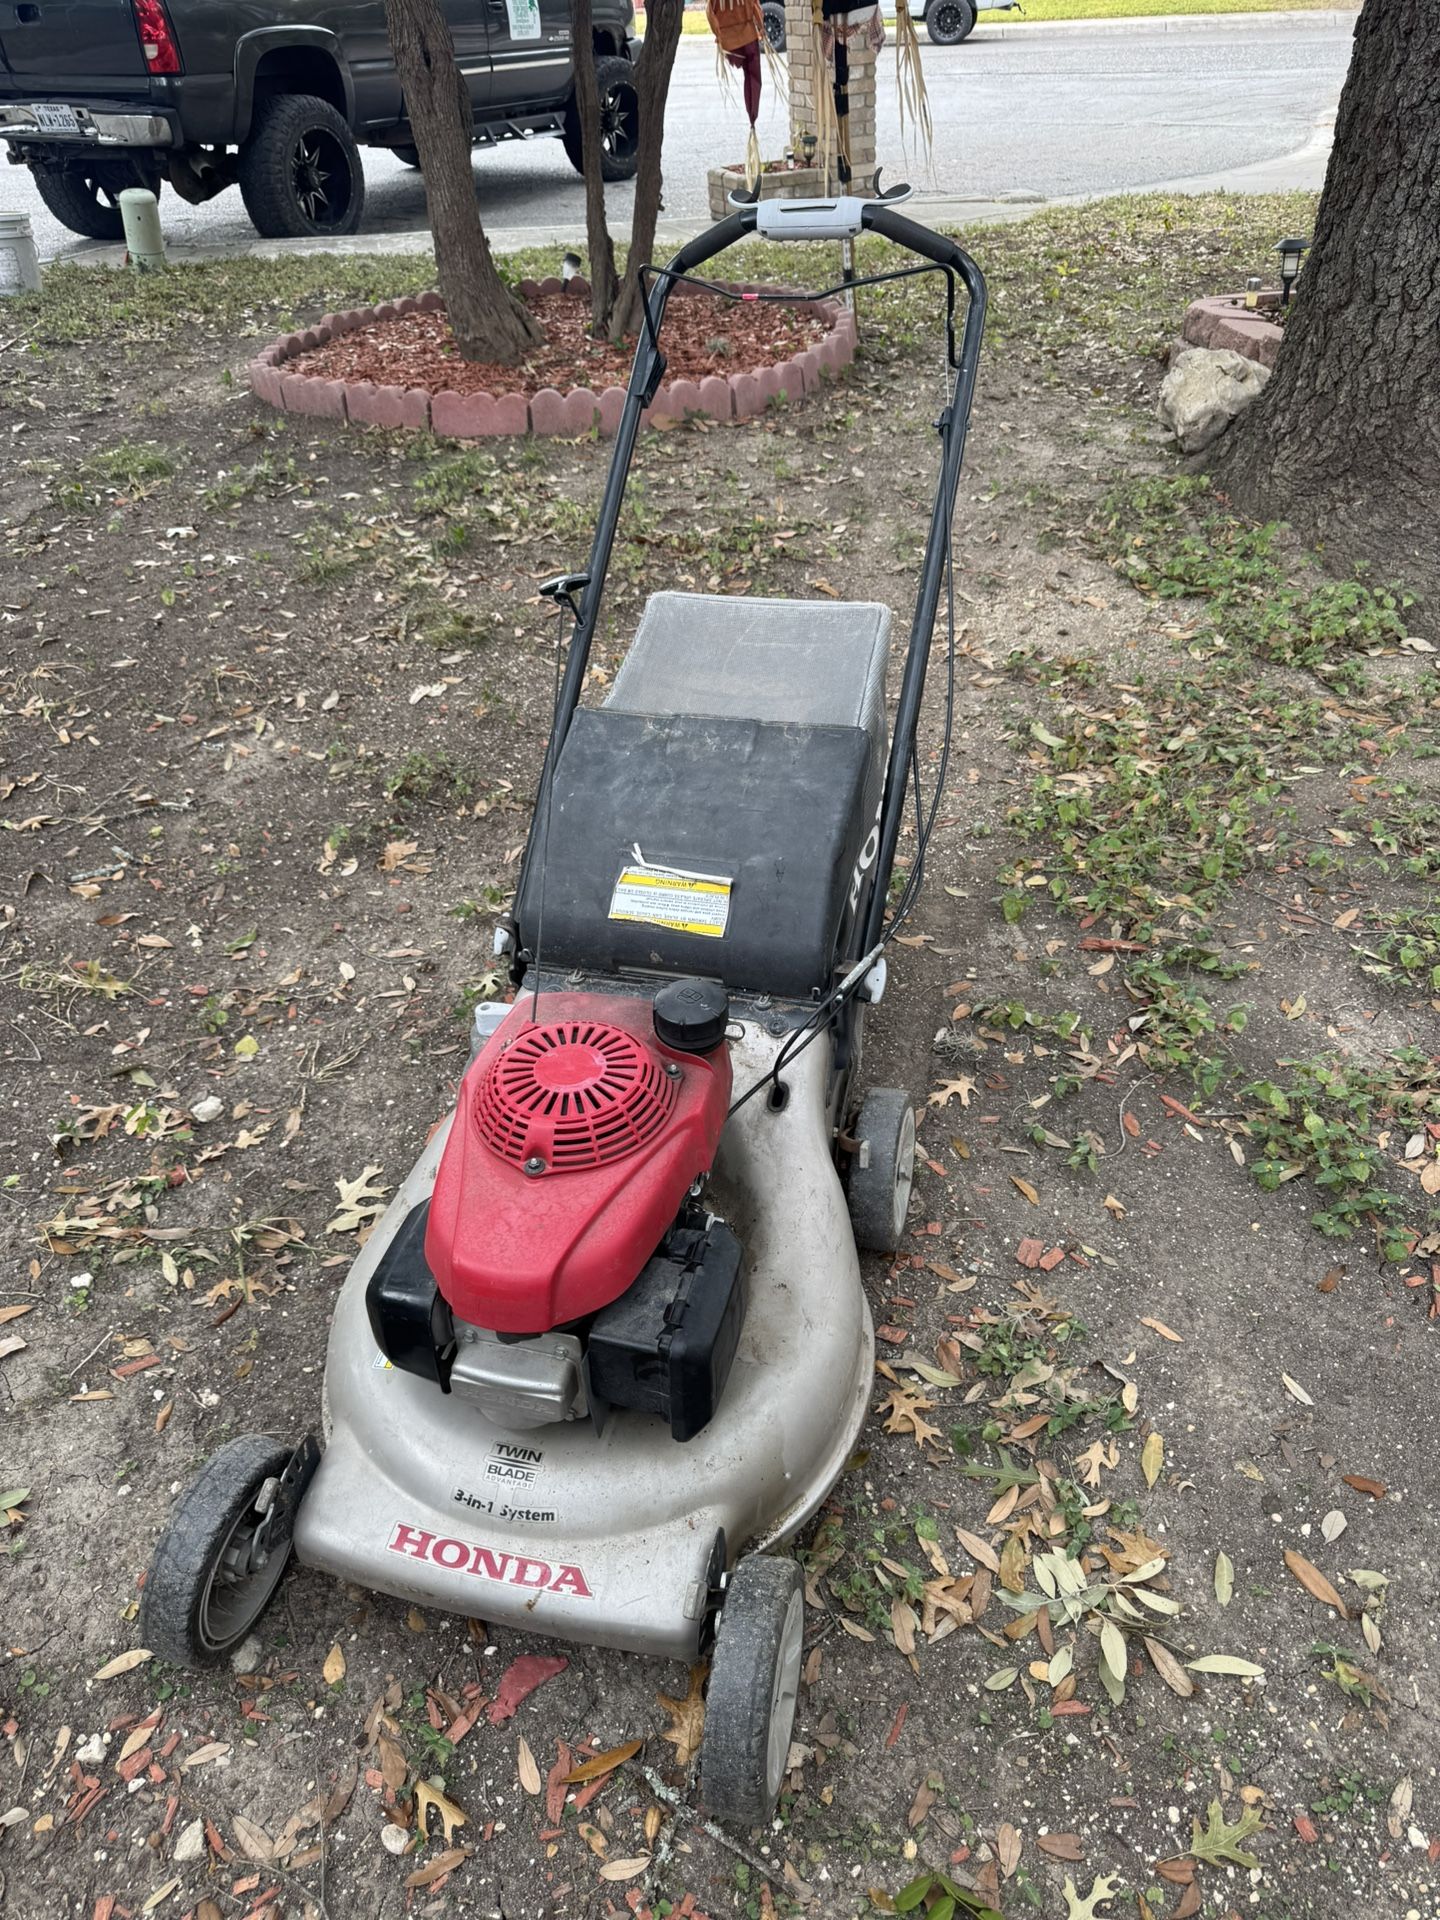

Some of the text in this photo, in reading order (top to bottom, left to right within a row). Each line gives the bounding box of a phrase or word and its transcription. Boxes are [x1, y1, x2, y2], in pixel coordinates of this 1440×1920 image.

[655, 879, 687, 888] WARNING
[496, 1443, 543, 1463] TWIN
[486, 1475, 533, 1489] ADVANTAGE
[487, 1464, 536, 1482] BLADE
[454, 1489, 555, 1523] 3-in-1 System
[389, 1524, 593, 1598] HONDA
